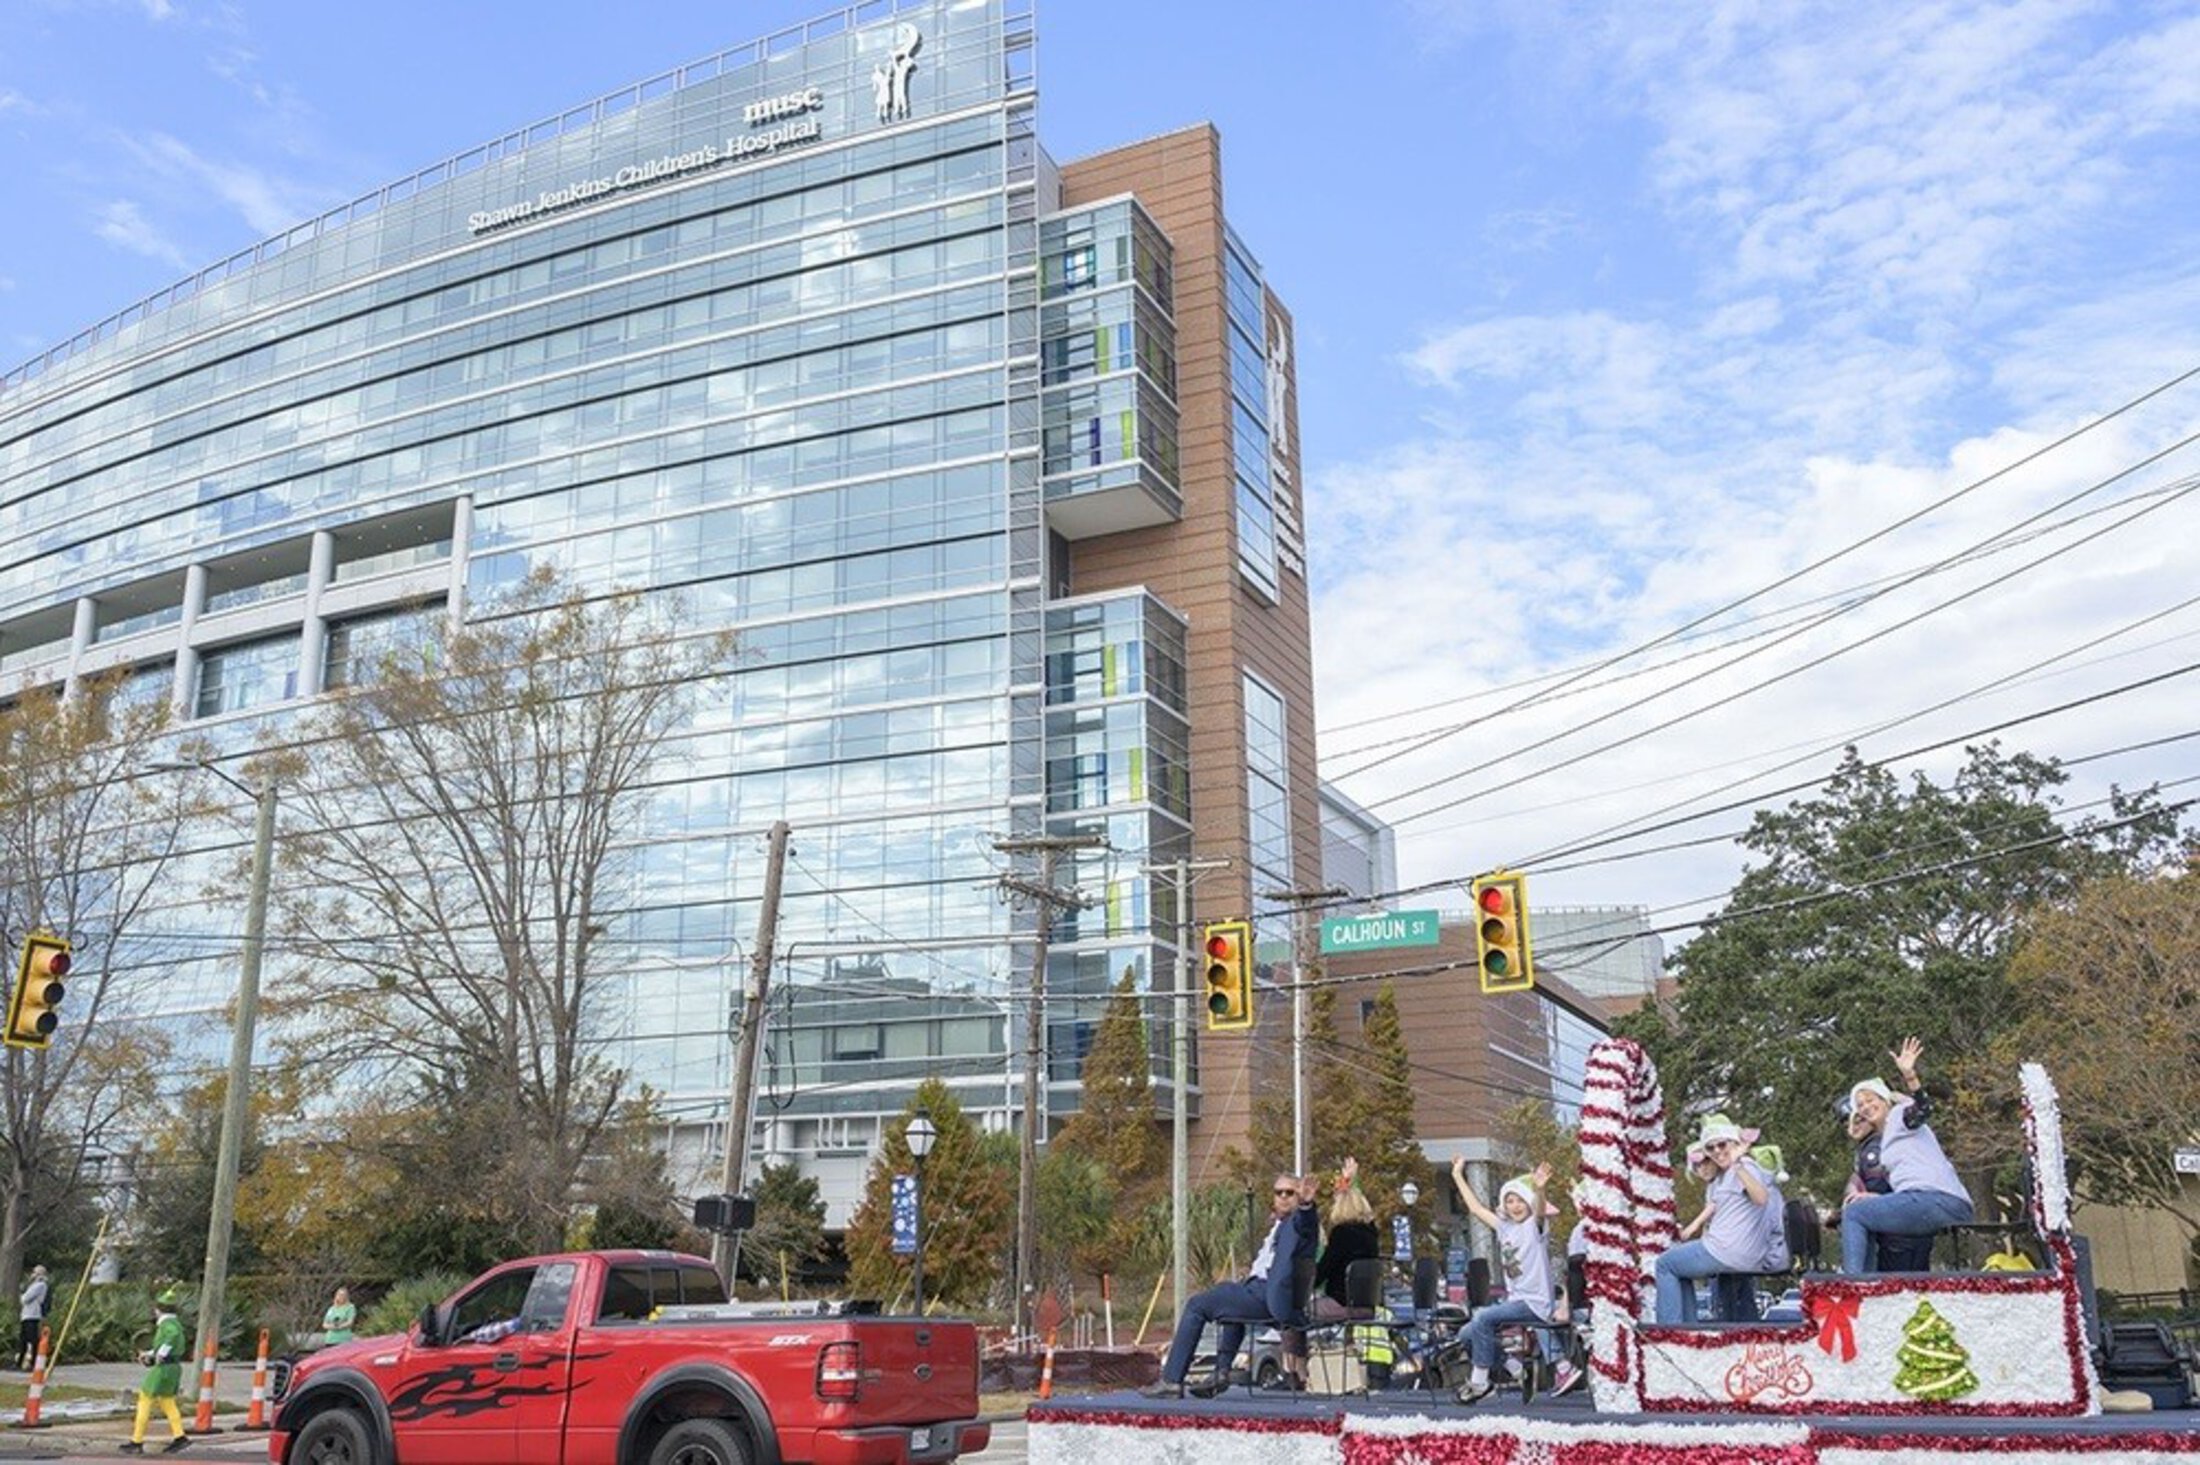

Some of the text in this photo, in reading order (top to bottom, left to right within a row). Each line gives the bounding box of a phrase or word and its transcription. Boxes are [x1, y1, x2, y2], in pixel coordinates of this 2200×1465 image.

[743, 86, 821, 122] musc
[468, 116, 818, 231] Shawn Jenkins Children's Hospital
[1332, 919, 1426, 945] CALHOUN ST
